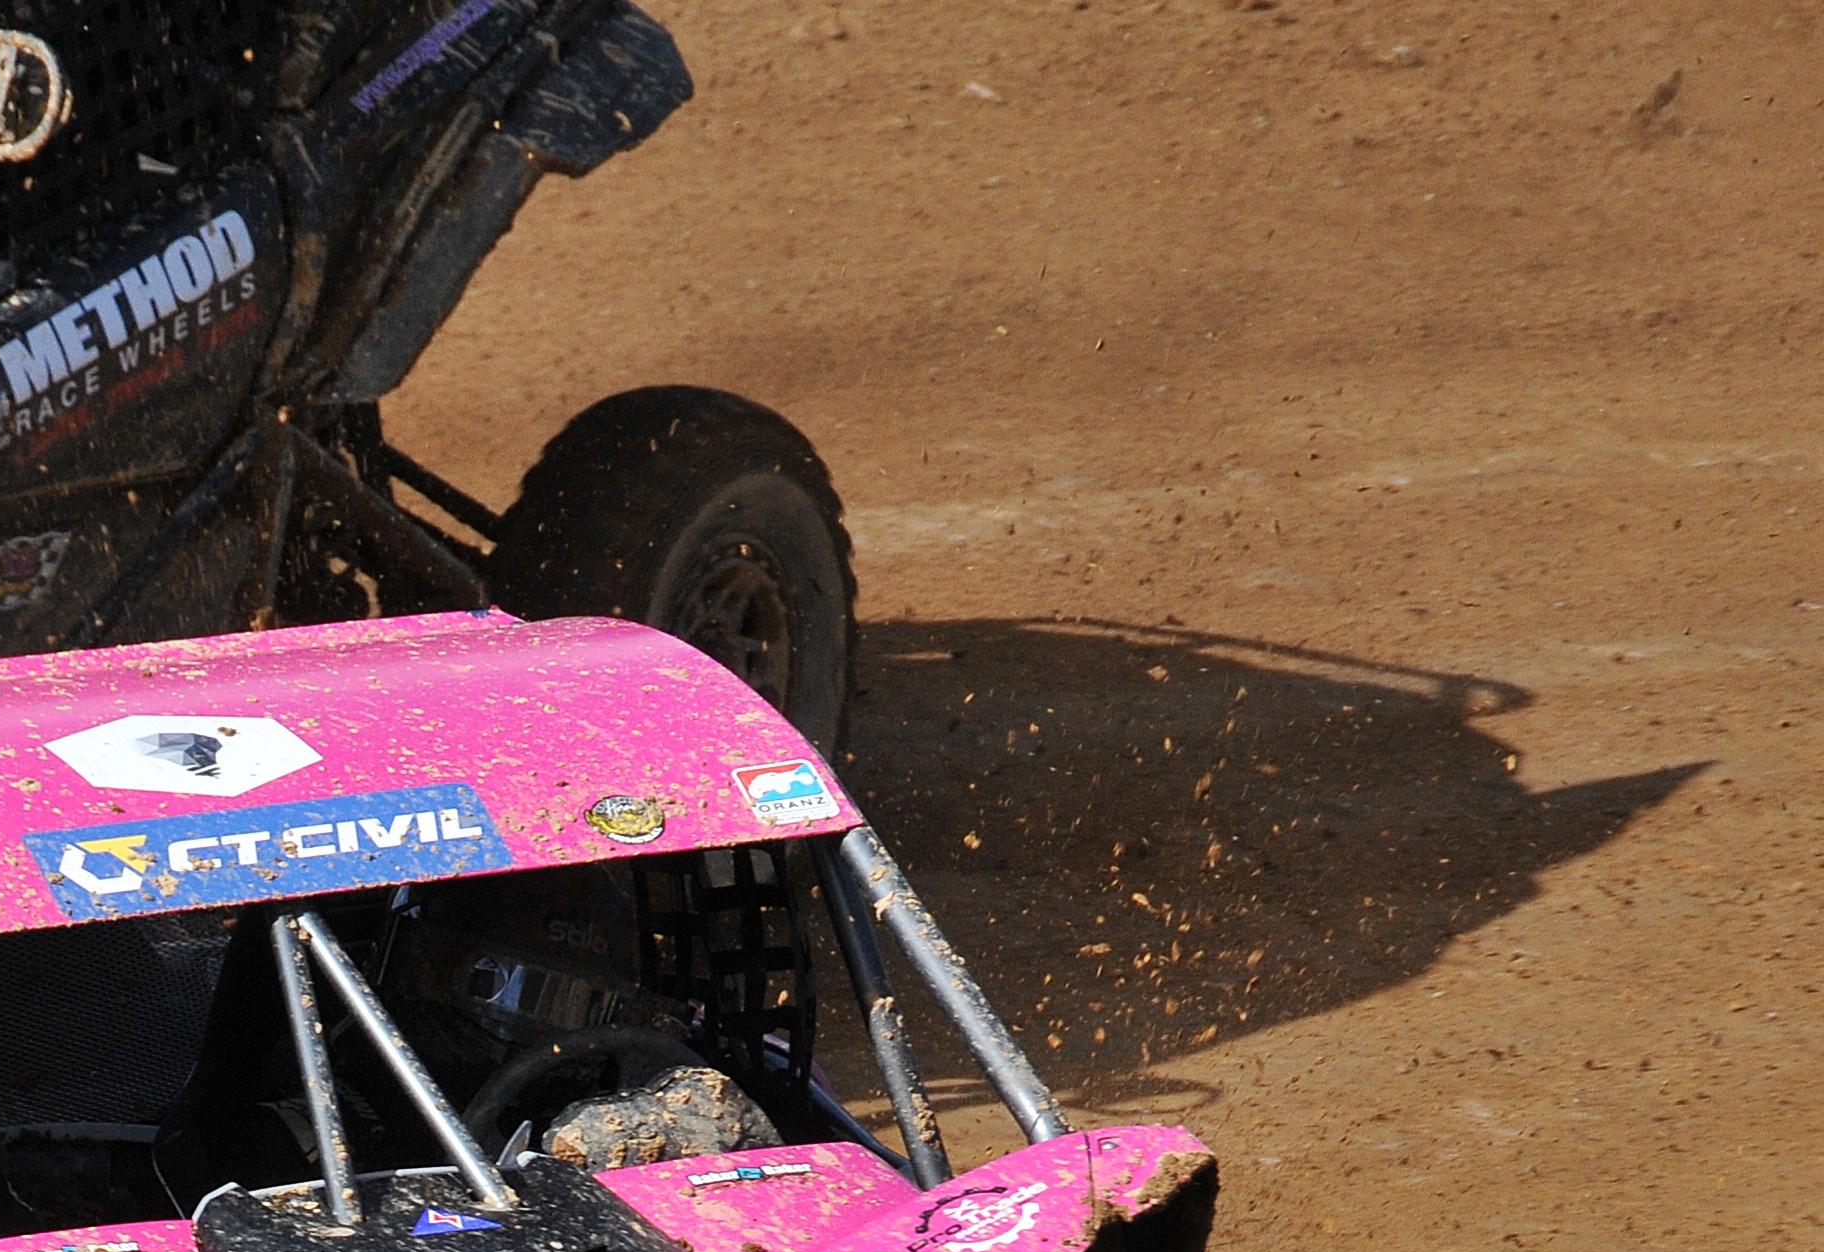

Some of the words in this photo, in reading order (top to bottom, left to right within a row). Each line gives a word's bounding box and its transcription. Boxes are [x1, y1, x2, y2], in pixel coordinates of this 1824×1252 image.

[15, 366, 101, 436] RACE
[119, 271, 258, 373] WHEELS
[758, 796, 827, 813] ORANZ
[281, 808, 483, 859] CIVIL
